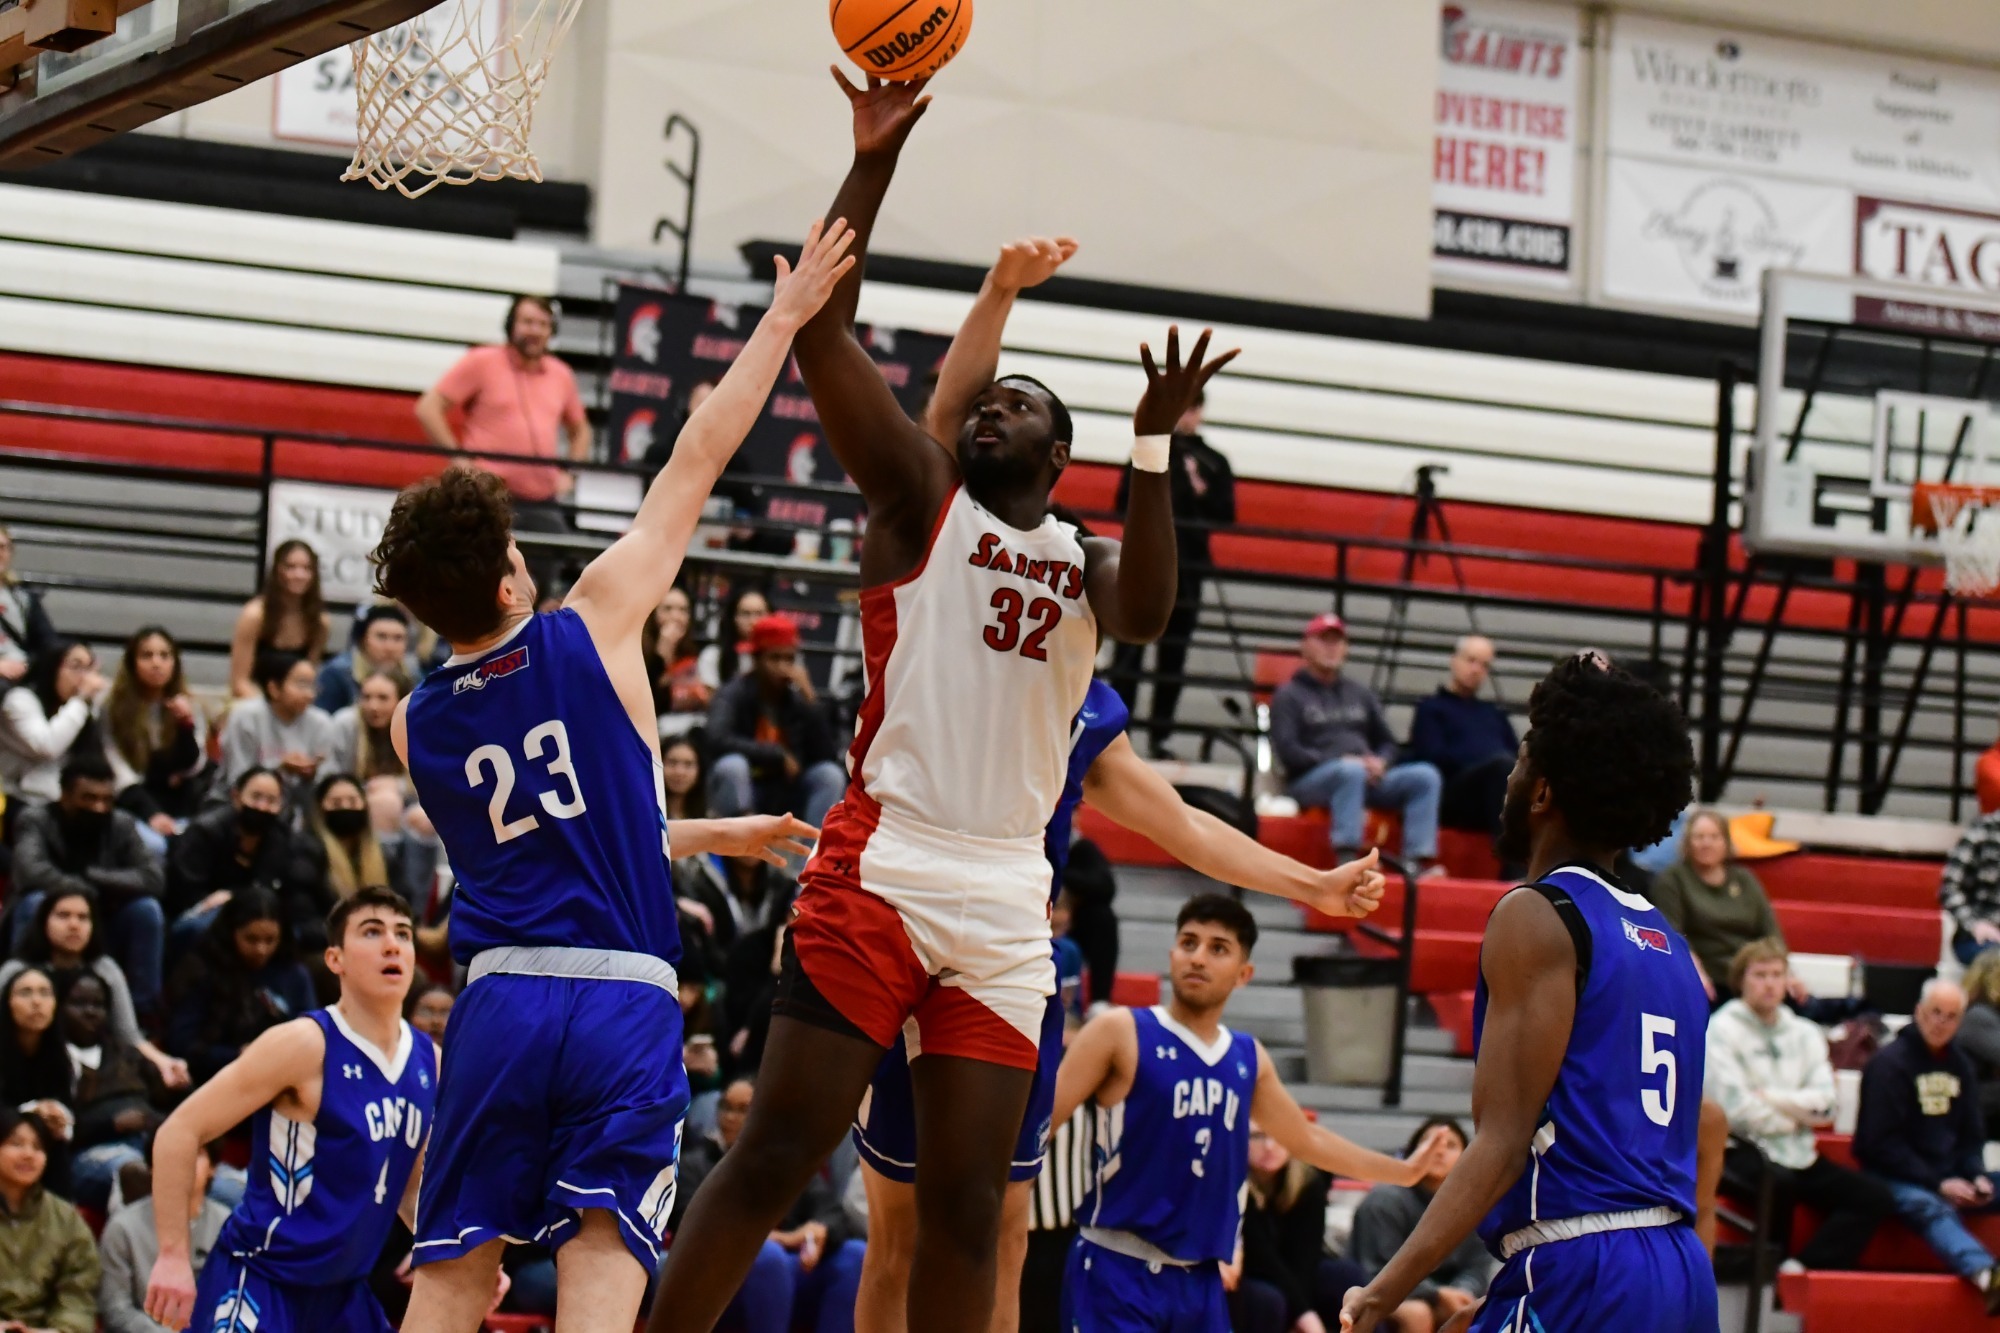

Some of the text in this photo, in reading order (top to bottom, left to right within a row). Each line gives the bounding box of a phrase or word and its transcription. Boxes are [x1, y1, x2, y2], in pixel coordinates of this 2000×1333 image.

[863, 6, 949, 68] Wilson
[1448, 30, 1567, 79] SAINTS
[1434, 136, 1546, 197] HERE!
[968, 532, 1084, 600] SAINTS
[983, 587, 1062, 662] 32
[464, 719, 587, 845] 23
[1640, 1012, 1677, 1128] 5
[1191, 1127, 1212, 1178] 3
